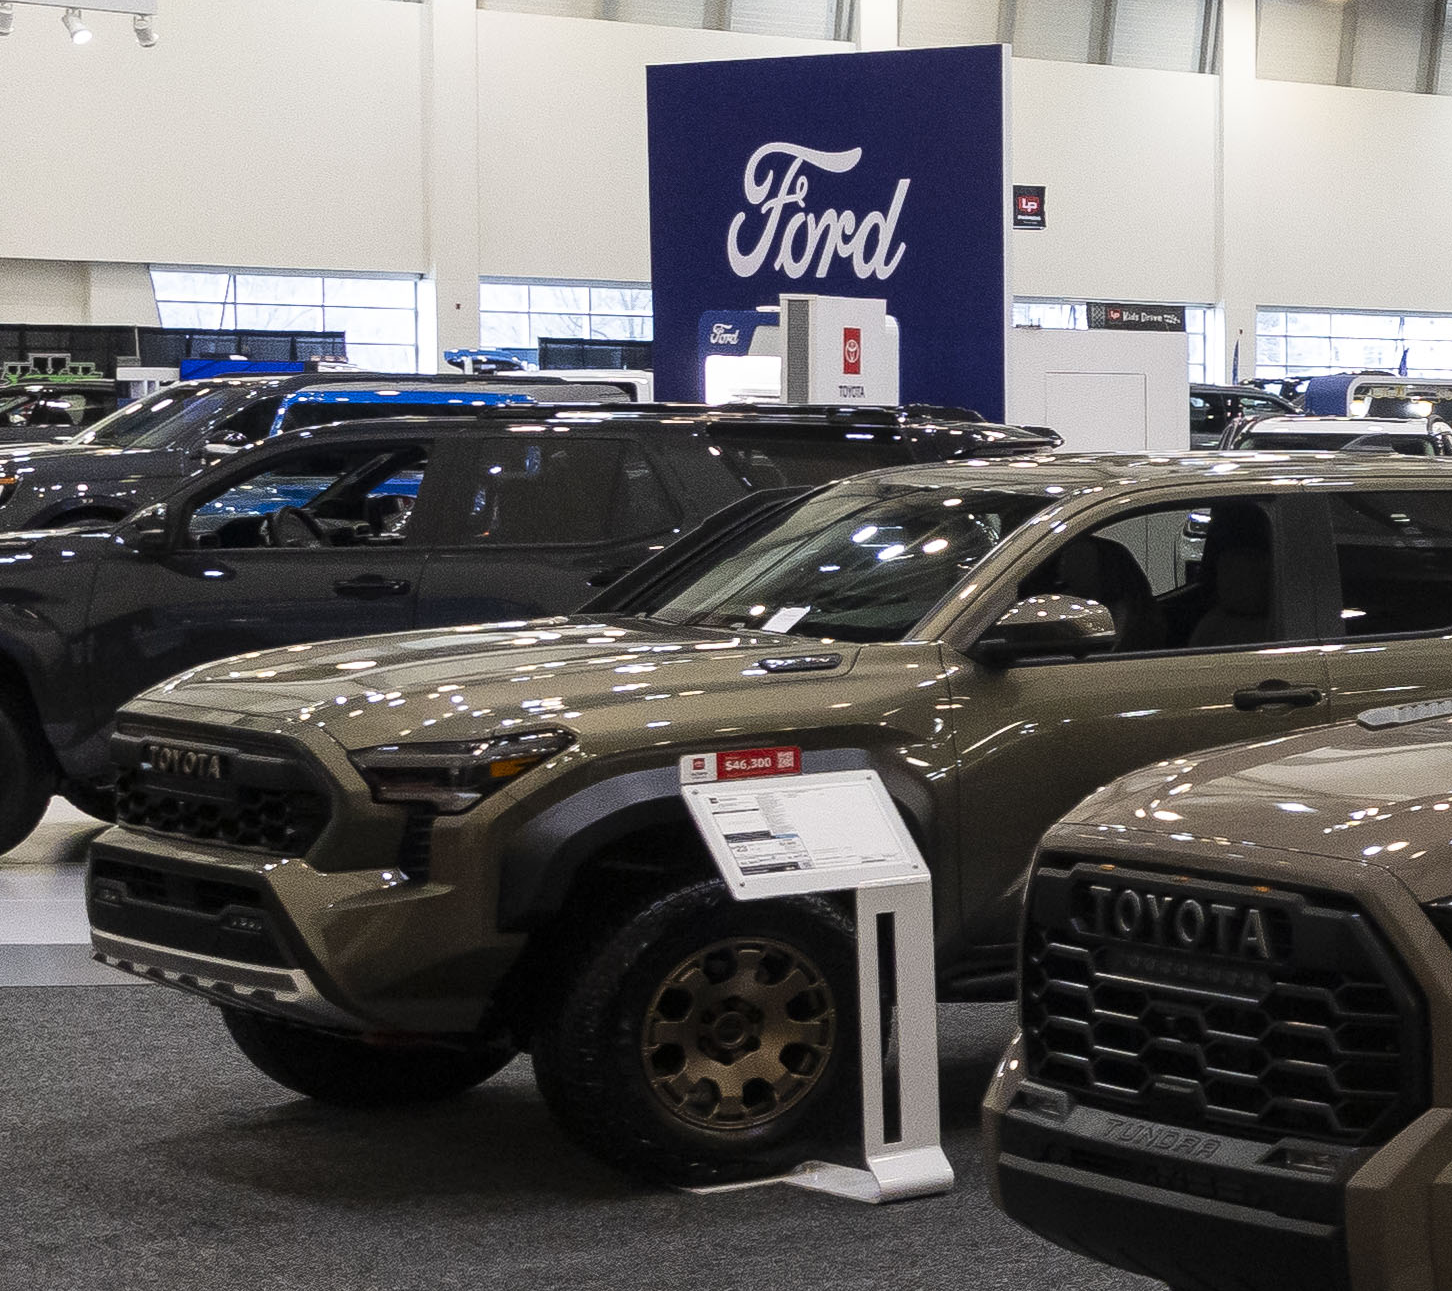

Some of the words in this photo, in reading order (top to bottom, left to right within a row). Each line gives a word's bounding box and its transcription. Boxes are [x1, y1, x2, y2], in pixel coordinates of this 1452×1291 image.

[727, 141, 911, 280] Ford
[1122, 310, 1140, 322] Kids
[709, 322, 740, 345] Ford
[838, 385, 866, 399] TOYOTA
[149, 745, 220, 779] TOYOTA
[1089, 885, 1270, 959] TOYOTA
[1103, 1117, 1222, 1159] TUNDRA
